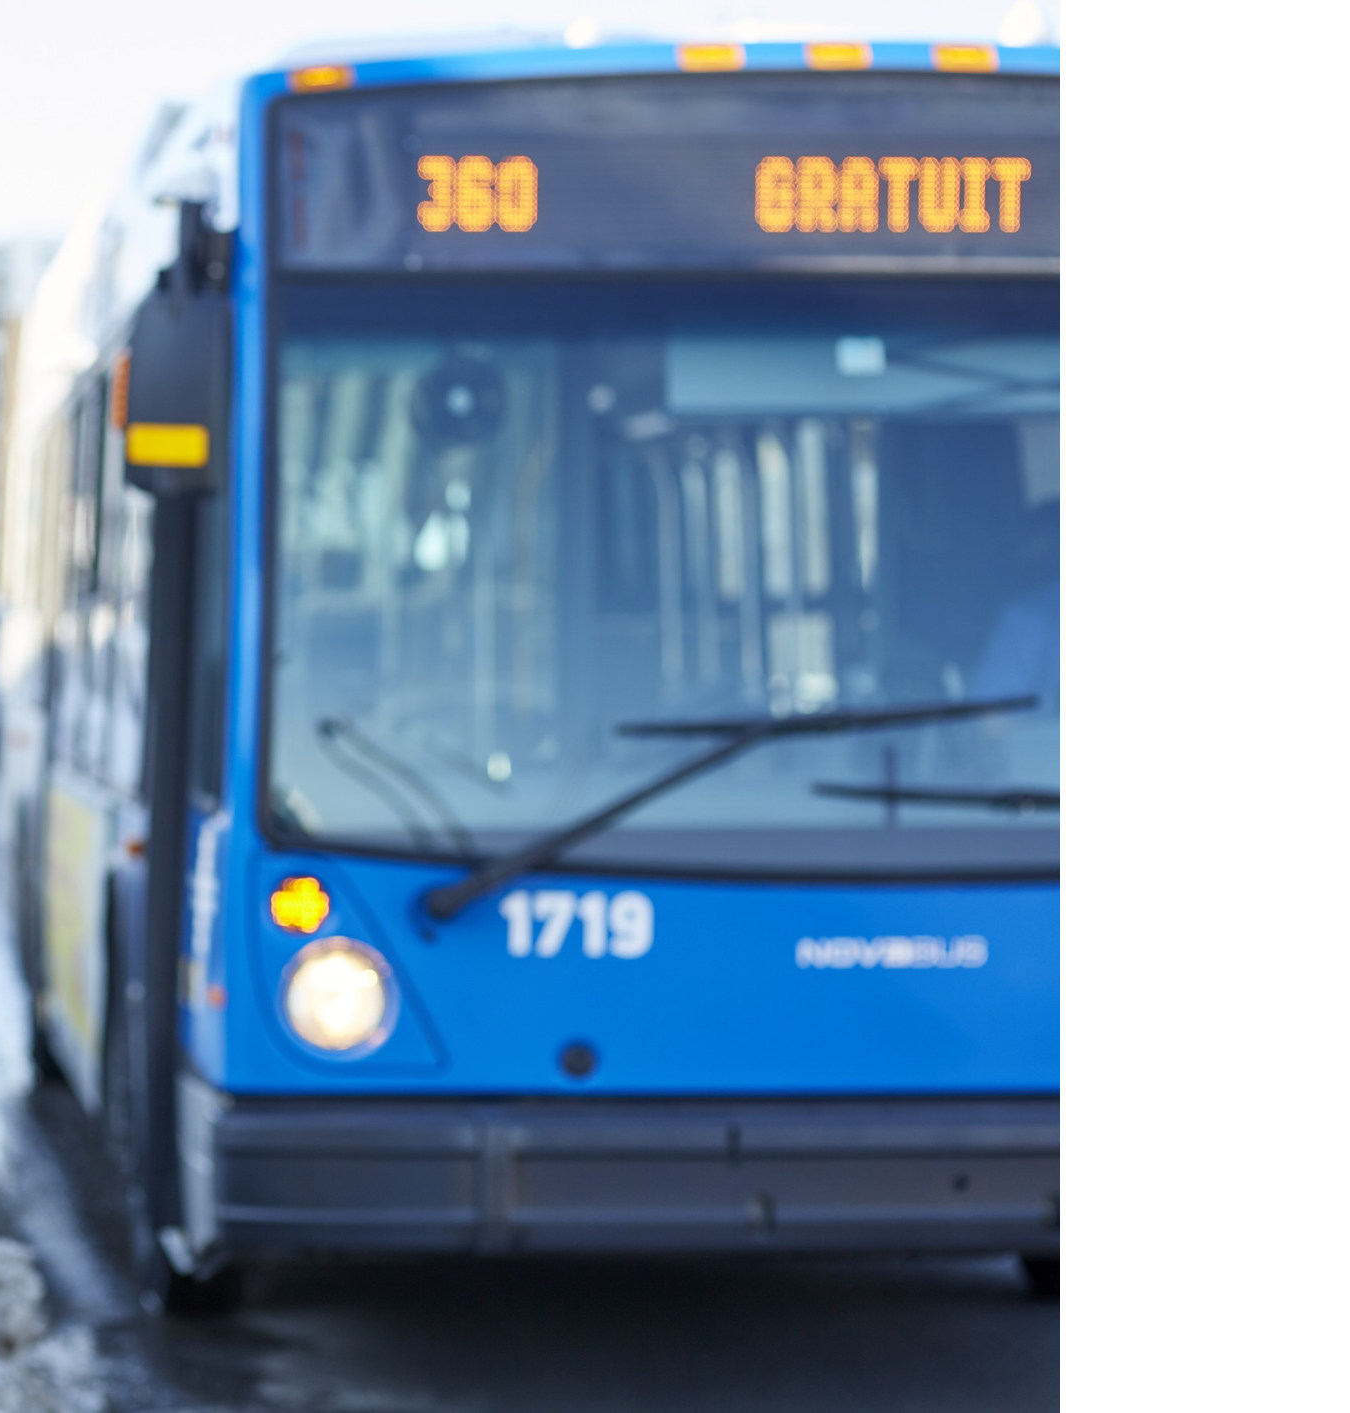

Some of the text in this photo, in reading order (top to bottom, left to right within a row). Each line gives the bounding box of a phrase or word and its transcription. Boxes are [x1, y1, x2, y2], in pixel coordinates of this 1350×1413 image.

[417, 155, 1032, 232] 360 GRATUIT
[499, 890, 655, 960] 1719
